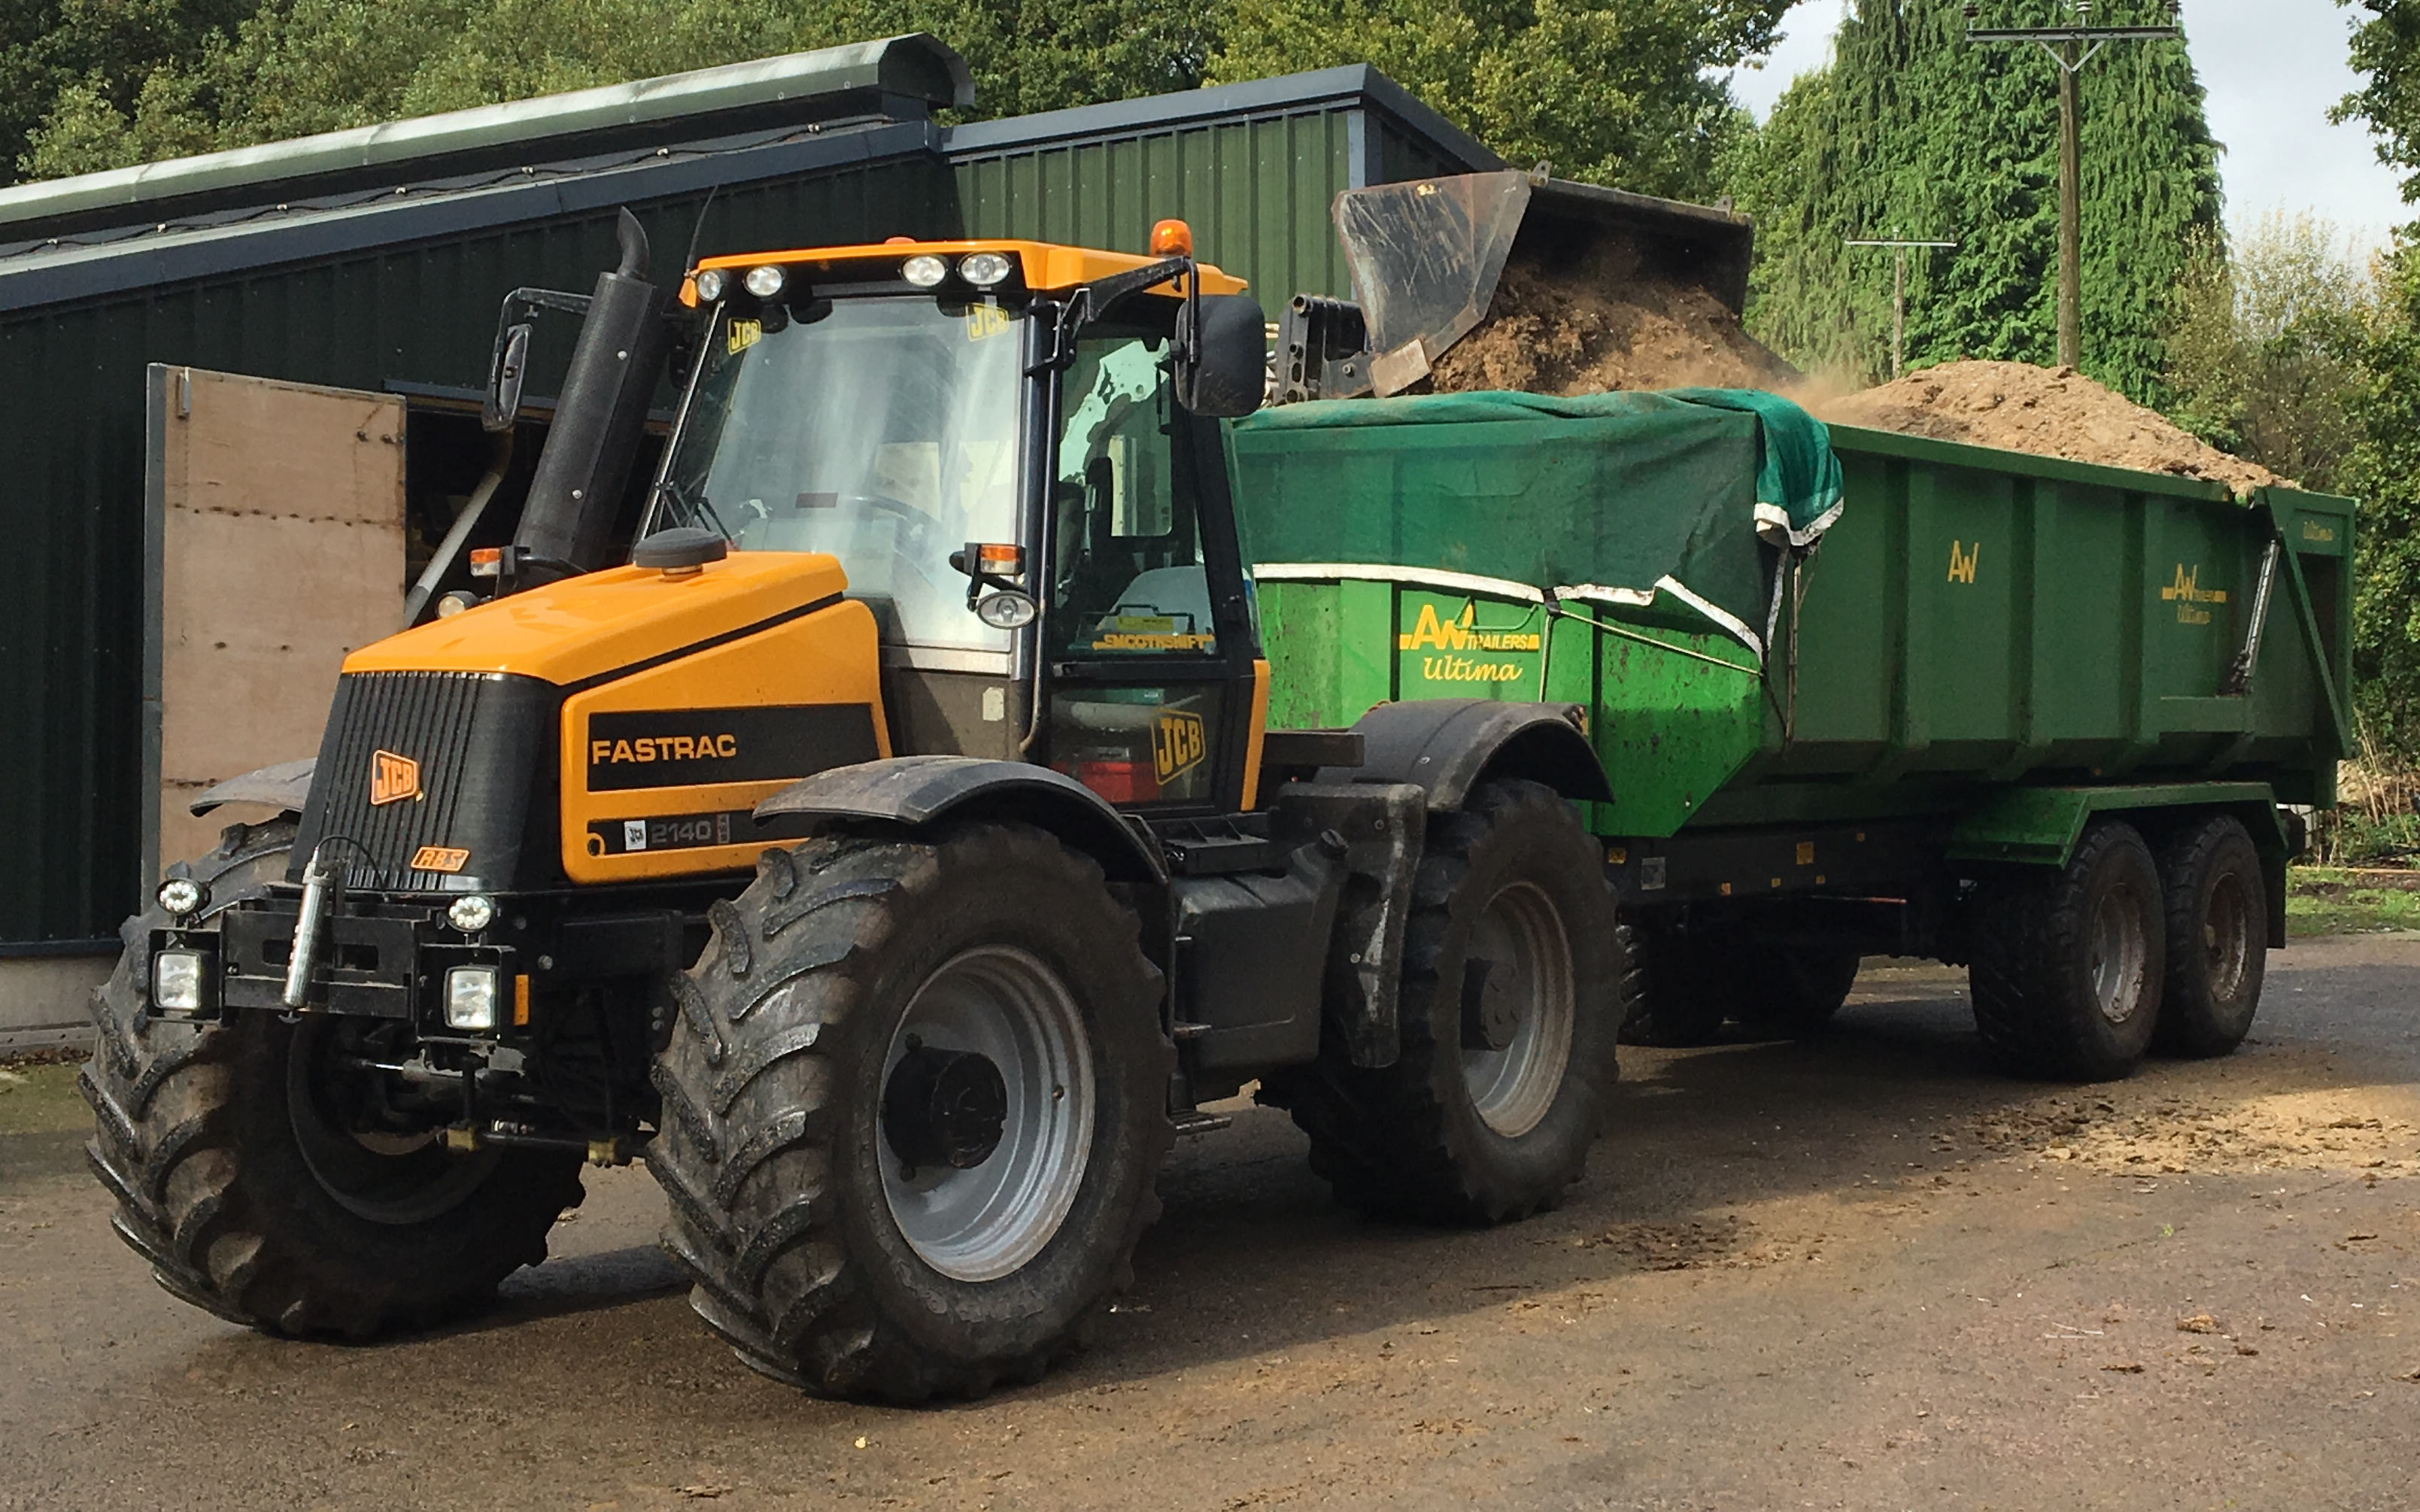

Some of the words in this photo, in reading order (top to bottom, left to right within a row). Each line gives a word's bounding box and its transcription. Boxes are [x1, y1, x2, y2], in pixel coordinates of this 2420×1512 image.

[731, 321, 761, 350] JCB
[970, 305, 1007, 338] JCB
[1467, 633, 1529, 651] TRAILERS
[1423, 654, 1524, 682] Ultima
[591, 733, 737, 765] FASTRAC
[1158, 717, 1201, 776] JCB
[375, 757, 413, 799] JCB
[651, 820, 712, 844] 2140
[418, 850, 462, 868] ABS
